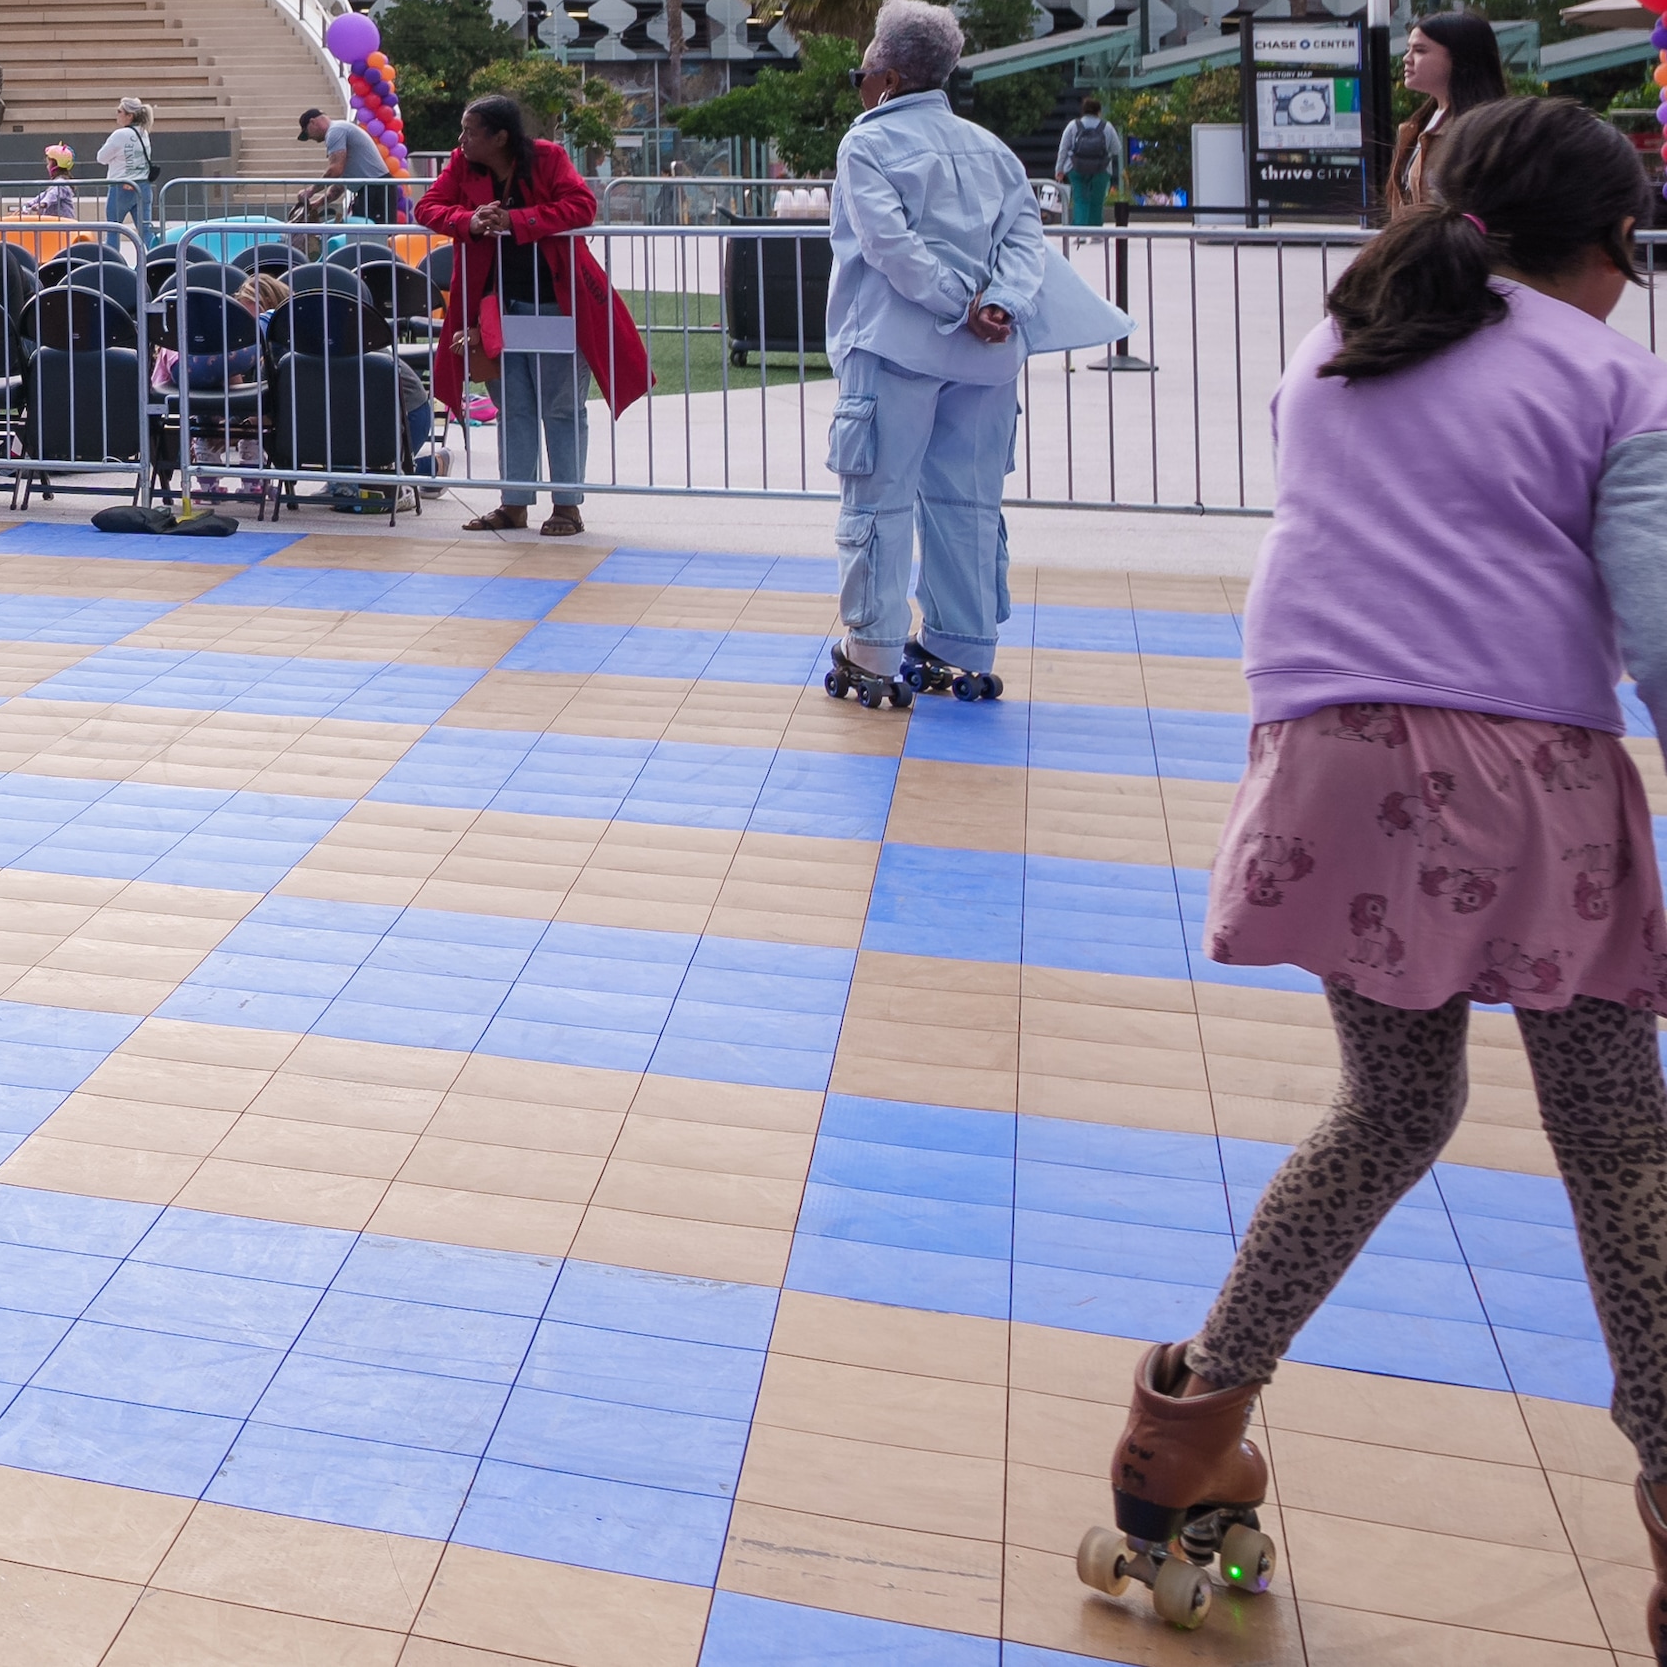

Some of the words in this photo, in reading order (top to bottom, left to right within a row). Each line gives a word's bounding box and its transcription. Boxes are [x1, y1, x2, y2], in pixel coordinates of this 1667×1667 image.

[1254, 39, 1297, 50] CHASE
[1313, 39, 1355, 49] CENTER
[1256, 71, 1296, 79] DIRECTORY
[1260, 164, 1314, 181] thrive
[1316, 168, 1352, 181] CITY
